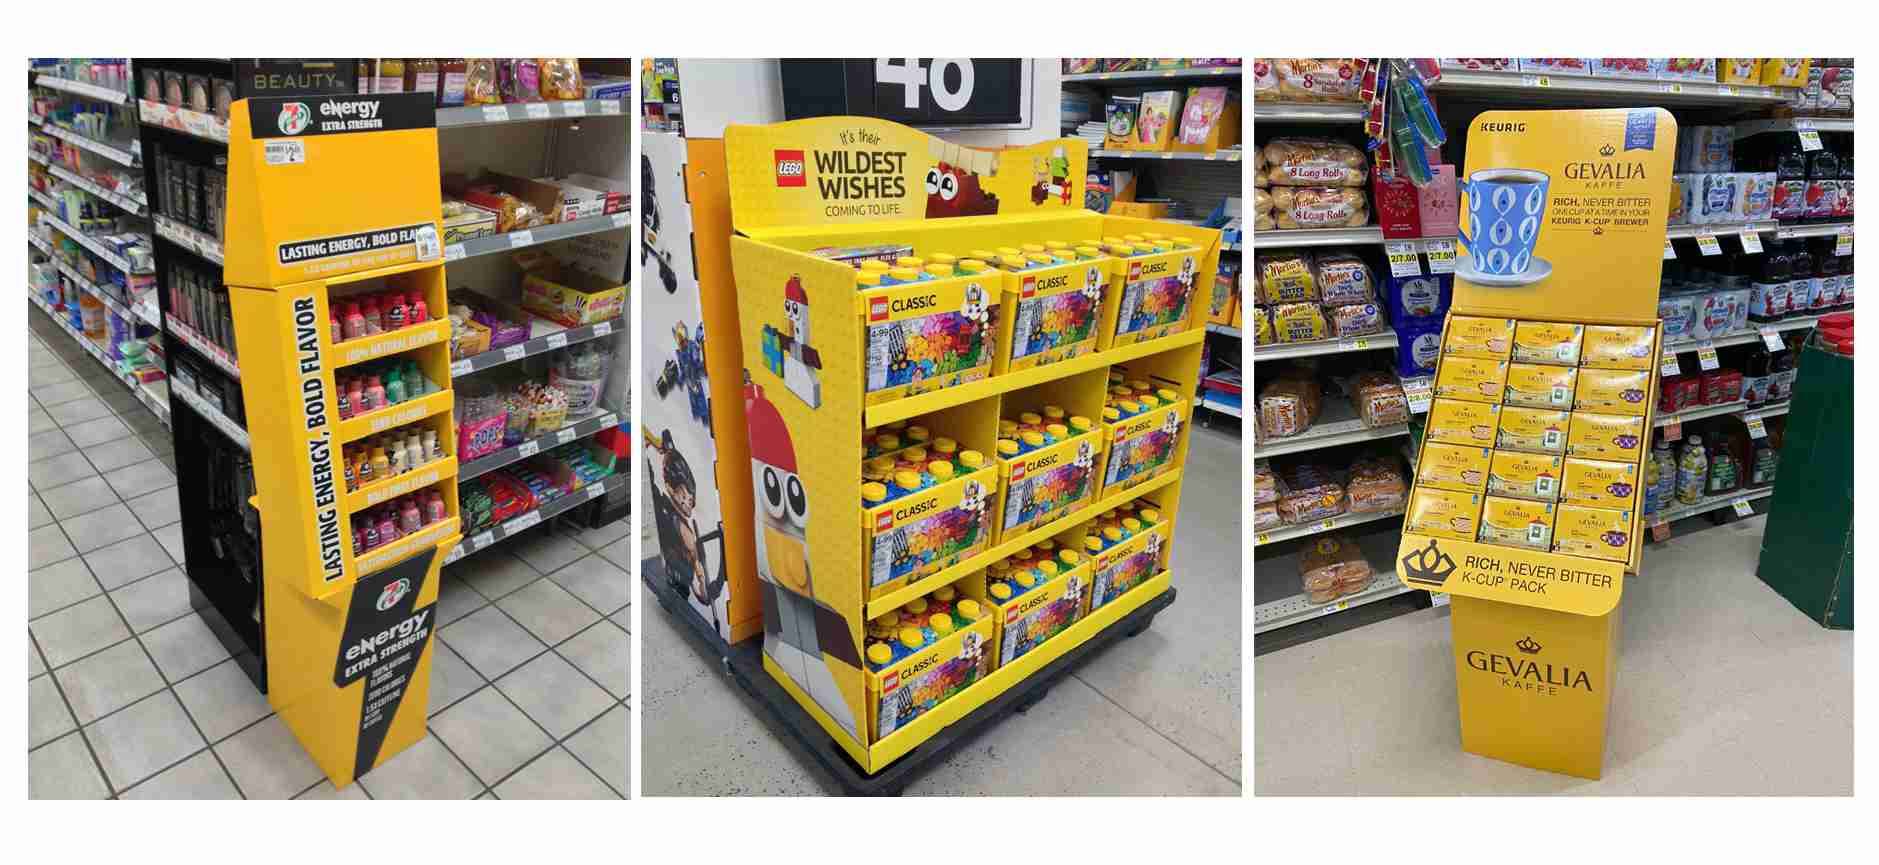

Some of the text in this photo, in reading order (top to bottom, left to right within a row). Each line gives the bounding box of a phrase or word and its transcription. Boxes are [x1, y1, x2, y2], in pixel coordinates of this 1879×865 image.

[254, 73, 336, 89] BEAUTY
[1303, 73, 1313, 88] 8
[322, 119, 383, 131] EXTRA STRENGTH
[1480, 122, 1526, 133] KEURIG
[859, 128, 881, 145] their
[777, 160, 802, 177] LEGO
[813, 150, 907, 175] WILDEST
[1564, 162, 1646, 180] GEVALIA
[1290, 167, 1344, 179] 8 Long Rolls
[817, 176, 906, 200] WISHES
[825, 204, 866, 217] COMING
[868, 204, 881, 216] TO
[1582, 197, 1614, 207] NEVER
[1616, 197, 1651, 207] BITTER
[1295, 210, 1301, 219] 8
[1303, 211, 1324, 221] Long
[1551, 217, 1649, 226] KEURIG K-CUP BREWER
[281, 243, 327, 260] LASTING
[328, 235, 371, 254] ENERGY,
[372, 231, 398, 247] BOLD
[1142, 261, 1168, 274] CLASSIC
[1037, 275, 1068, 290] CLASSIC
[892, 294, 937, 312] CLASSIC
[1126, 419, 1152, 436] CLASSIC
[294, 297, 343, 582] LASTING ENERGY, BOLD FLAVOR
[1026, 453, 1059, 473] CLASSIC
[895, 497, 938, 521] CLASSIC
[1109, 545, 1134, 564] CLASSIC
[1465, 555, 1613, 588] RICH, NEVER BITTER
[1462, 571, 1547, 594] K-CUP PACK
[1019, 591, 1049, 614] CLASSIC
[345, 628, 428, 678] EXTRA STRENGTH
[900, 653, 939, 680] CLASSIC
[1466, 650, 1593, 692] GEVALIA
[1502, 678, 1558, 696] KAFFE
